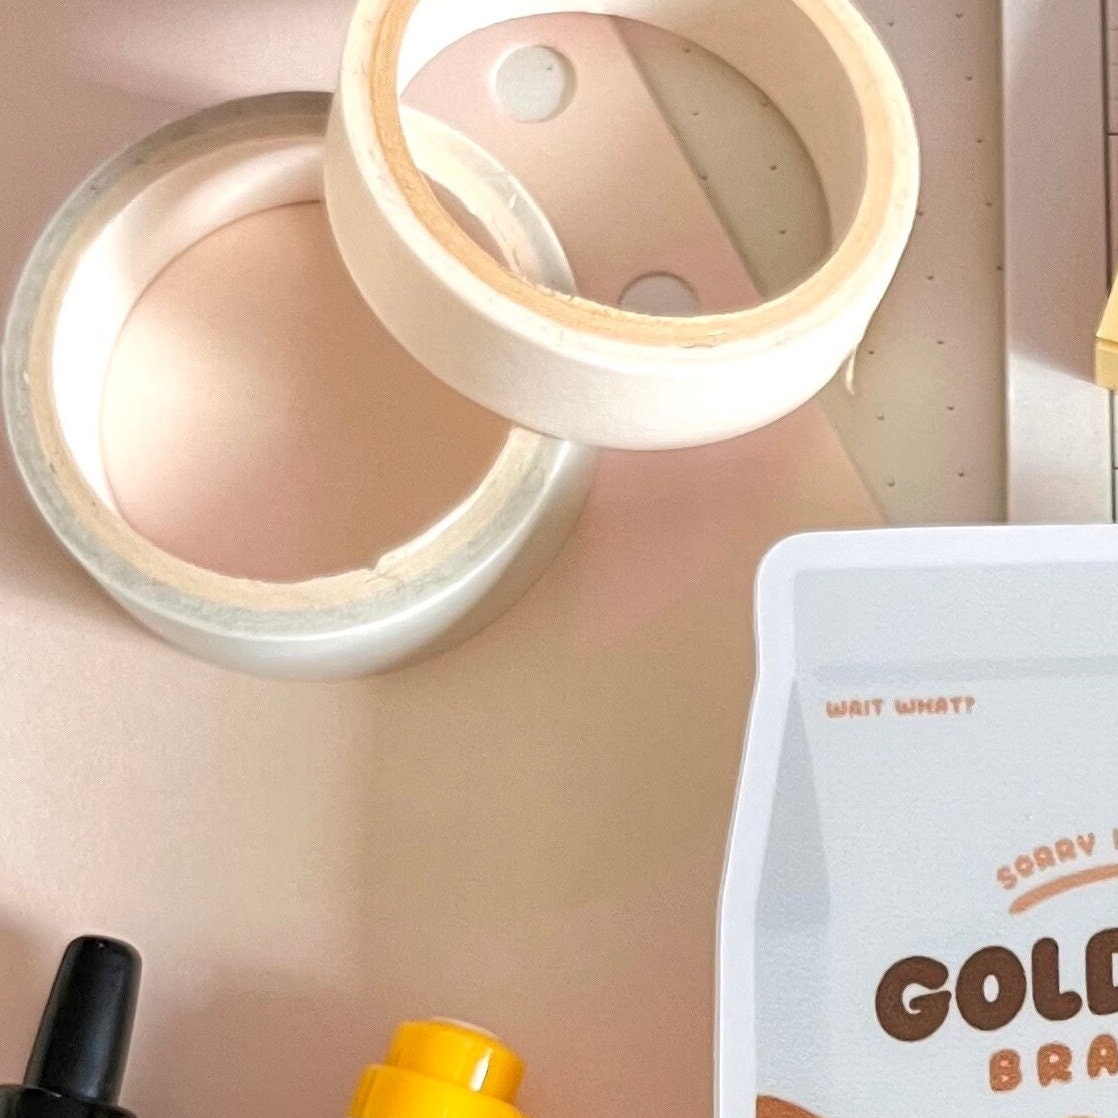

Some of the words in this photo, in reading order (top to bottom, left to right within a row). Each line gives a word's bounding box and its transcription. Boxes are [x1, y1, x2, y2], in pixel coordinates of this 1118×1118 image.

[826, 698, 882, 718] WAIT
[895, 696, 975, 715] WHAT?
[996, 832, 1097, 890] SORRY
